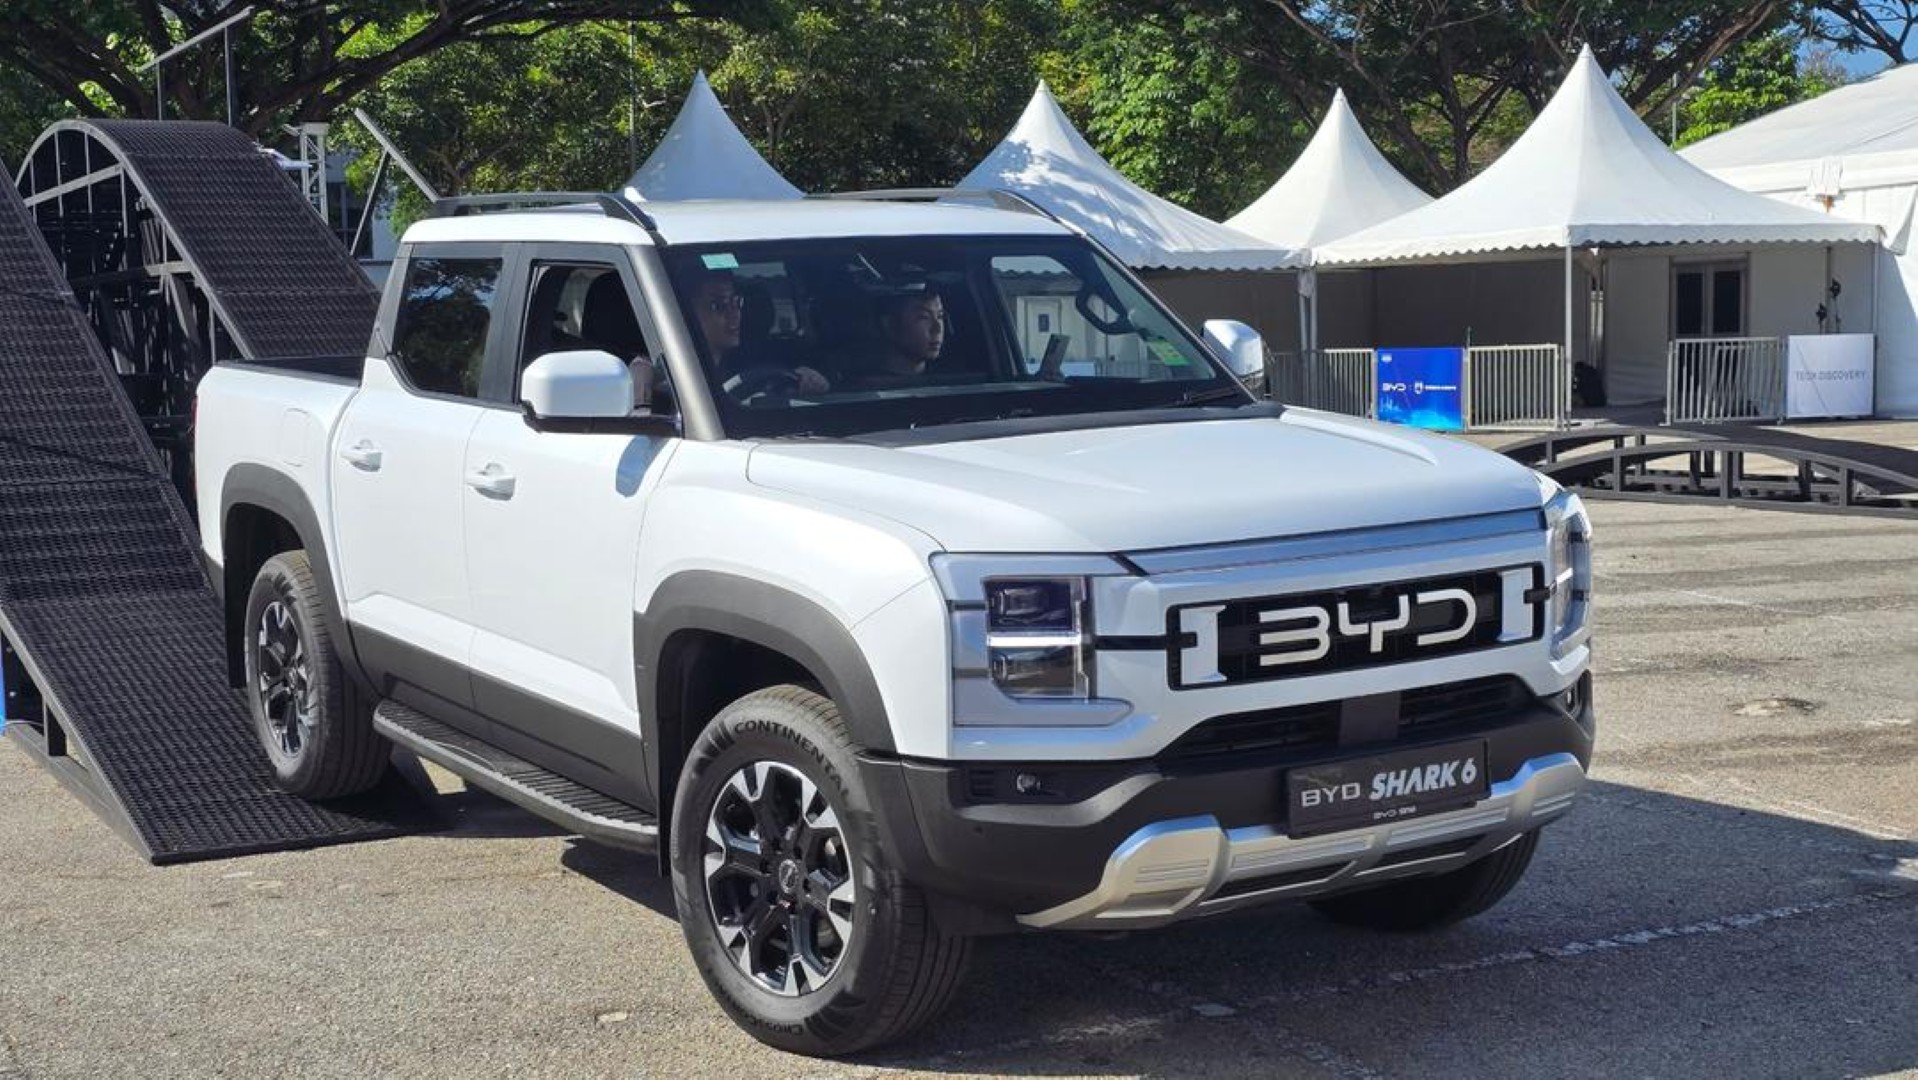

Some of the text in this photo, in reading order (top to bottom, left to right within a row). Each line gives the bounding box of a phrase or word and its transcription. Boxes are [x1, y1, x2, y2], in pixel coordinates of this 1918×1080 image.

[1382, 382, 1406, 391] BYD
[1818, 370, 1865, 381] DISCOVERY
[1259, 588, 1477, 666] BYD
[734, 719, 849, 799] CONTINENTAL
[1302, 757, 1478, 807] BYD SHARK 6
